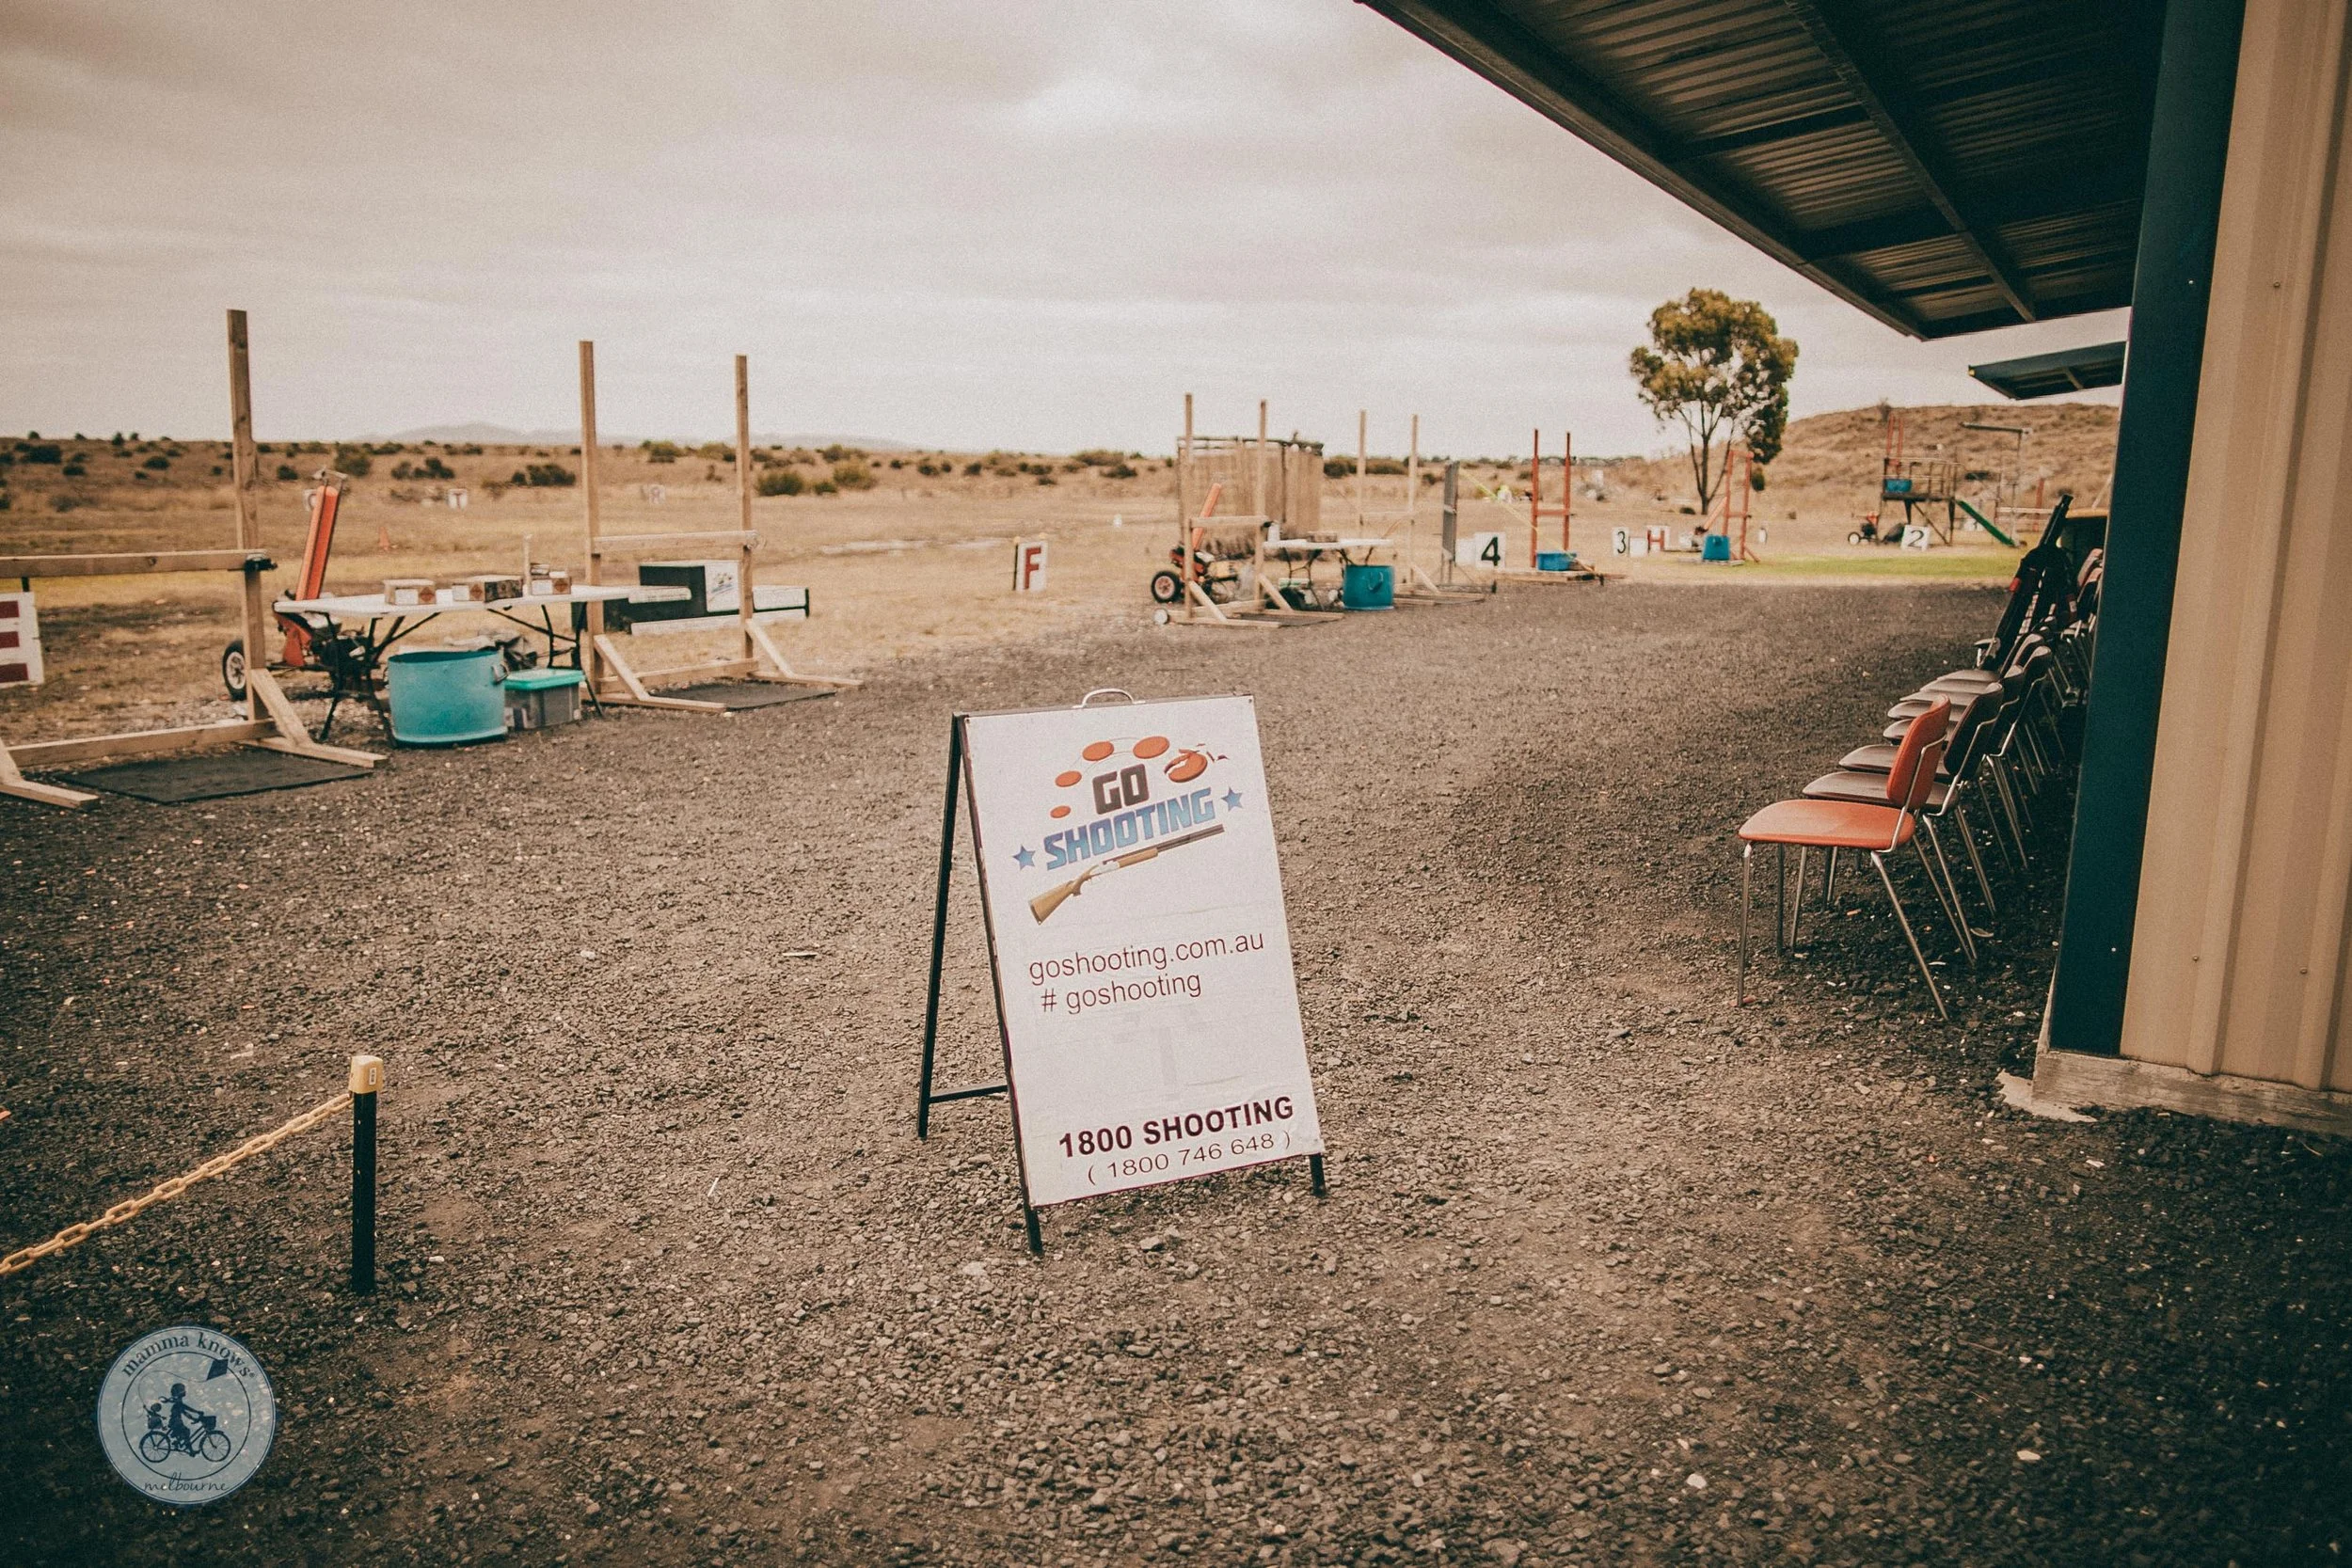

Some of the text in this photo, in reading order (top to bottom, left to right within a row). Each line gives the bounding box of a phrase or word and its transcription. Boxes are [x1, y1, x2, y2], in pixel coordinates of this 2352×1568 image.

[1481, 536, 1501, 566] 4
[1617, 531, 1627, 554] 3
[1646, 530, 1665, 553] H
[1907, 530, 1924, 548] 2
[1025, 546, 1041, 590] F
[1092, 763, 1150, 816] GO
[1042, 786, 1216, 871] SHOOTING
[1028, 933, 1264, 987] goshooting.com.au
[1041, 973, 1201, 1015] # goshooting
[1059, 1096, 1294, 1158] 1800 SHOOTING
[1107, 1153, 1169, 1178] 1800
[1178, 1143, 1222, 1165] 746
[1231, 1132, 1274, 1155] 648
